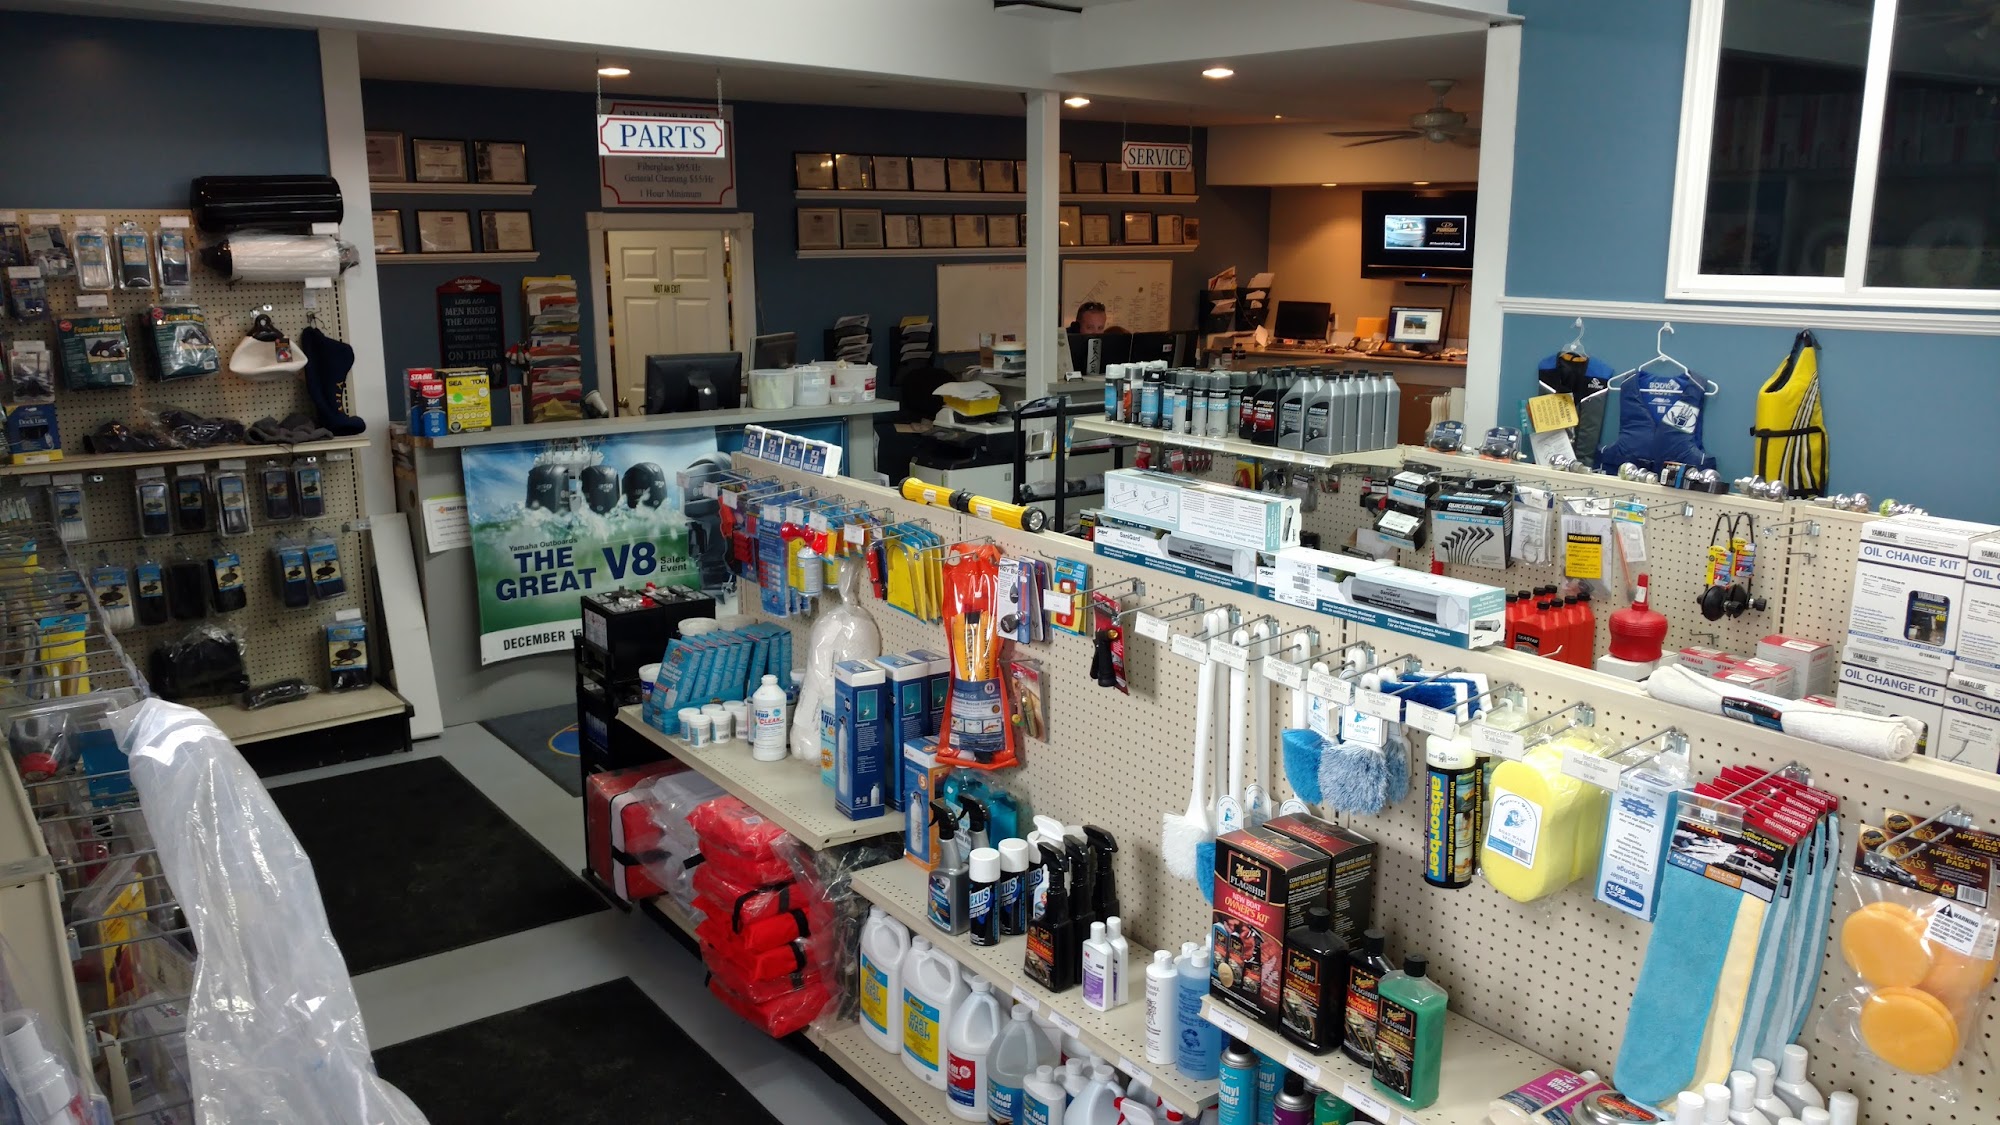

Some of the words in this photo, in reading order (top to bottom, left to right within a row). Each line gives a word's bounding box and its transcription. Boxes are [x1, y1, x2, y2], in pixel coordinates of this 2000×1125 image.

[620, 124, 705, 149] PARTS
[1128, 147, 1187, 167] SERVICE
[637, 163, 674, 173] Fiberglass
[624, 174, 654, 183] General
[656, 175, 688, 185] Cleaning
[647, 189, 665, 198] Hour
[667, 190, 702, 199] Minimum
[654, 284, 663, 294] NOT
[664, 284, 670, 294] AN
[671, 284, 681, 294] EXIT
[445, 307, 465, 316] MEN
[466, 306, 497, 316] KISSED
[446, 317, 463, 326] THE
[463, 317, 498, 326] GROUND
[448, 351, 464, 361] ON
[466, 350, 498, 361] THEIR
[471, 378, 487, 386] TOW
[1448, 502, 1486, 511] QUICKSILVER
[1568, 535, 1600, 543] WARNING!
[1872, 528, 1898, 540] YAMALUBE
[509, 542, 538, 552] Yamaha
[539, 537, 578, 548] Outboards
[513, 546, 574, 574] THE
[602, 542, 657, 581] V8
[660, 554, 686, 565] Sales
[1863, 545, 1883, 558] OIL
[1885, 549, 1937, 568] CHANGE
[1939, 558, 1961, 571] KIT
[660, 563, 687, 573] Event
[1972, 568, 1994, 580] OIL
[495, 567, 597, 601] GREAT
[1380, 589, 1401, 598] SaniGard
[503, 630, 566, 651] DECEMBER
[569, 628, 582, 642] 15
[1517, 634, 1539, 644] SEASTAR
[1852, 652, 1879, 664] YAMALUBE
[1845, 668, 1863, 681] OIL
[1866, 672, 1916, 693] CHANGE
[1918, 686, 1938, 698] KIT
[1958, 679, 1988, 692] YAMALUBE
[1952, 695, 1972, 707] OIL
[1449, 781, 1457, 796] Dries
[1795, 790, 1826, 806] SHURHOLD
[1448, 798, 1457, 822] anything
[1785, 797, 1817, 815] SHURHOLD
[1773, 811, 1807, 829] SHURHOLD
[1780, 806, 1813, 823] SHURHOLD
[1429, 775, 1444, 876] absorber
[1764, 818, 1798, 838] SHURHOLD
[1762, 837, 1785, 851] Towels
[1972, 842, 1999, 853] PADS
[1929, 848, 1988, 869] APPLICATOR
[1945, 858, 1972, 870] PADS
[1610, 871, 1629, 885] Bailer
[1616, 865, 1640, 880] Sponge
[1229, 876, 1267, 898] FLAGSHIP
[1629, 879, 1644, 891] Boat
[1232, 892, 1243, 904] NEW
[1243, 896, 1261, 910] BOAT
[1224, 896, 1256, 919] OWNER'S
[1256, 911, 1270, 925] KIT
[1953, 912, 1979, 928] WARNING
[1289, 964, 1316, 982] FLAGSHIP
[865, 975, 880, 992] BOAT
[864, 985, 881, 1006] WASH
[1346, 995, 1366, 1012] Marine
[909, 1011, 928, 1030] BOAT
[1381, 1016, 1410, 1036] FLAGSHIP
[908, 1021, 931, 1041] WASH
[1545, 1081, 1568, 1095] Wax
[1553, 1076, 1575, 1092] Maxi
[996, 1090, 1011, 1103] Hull
[1033, 1109, 1047, 1123] Hull
